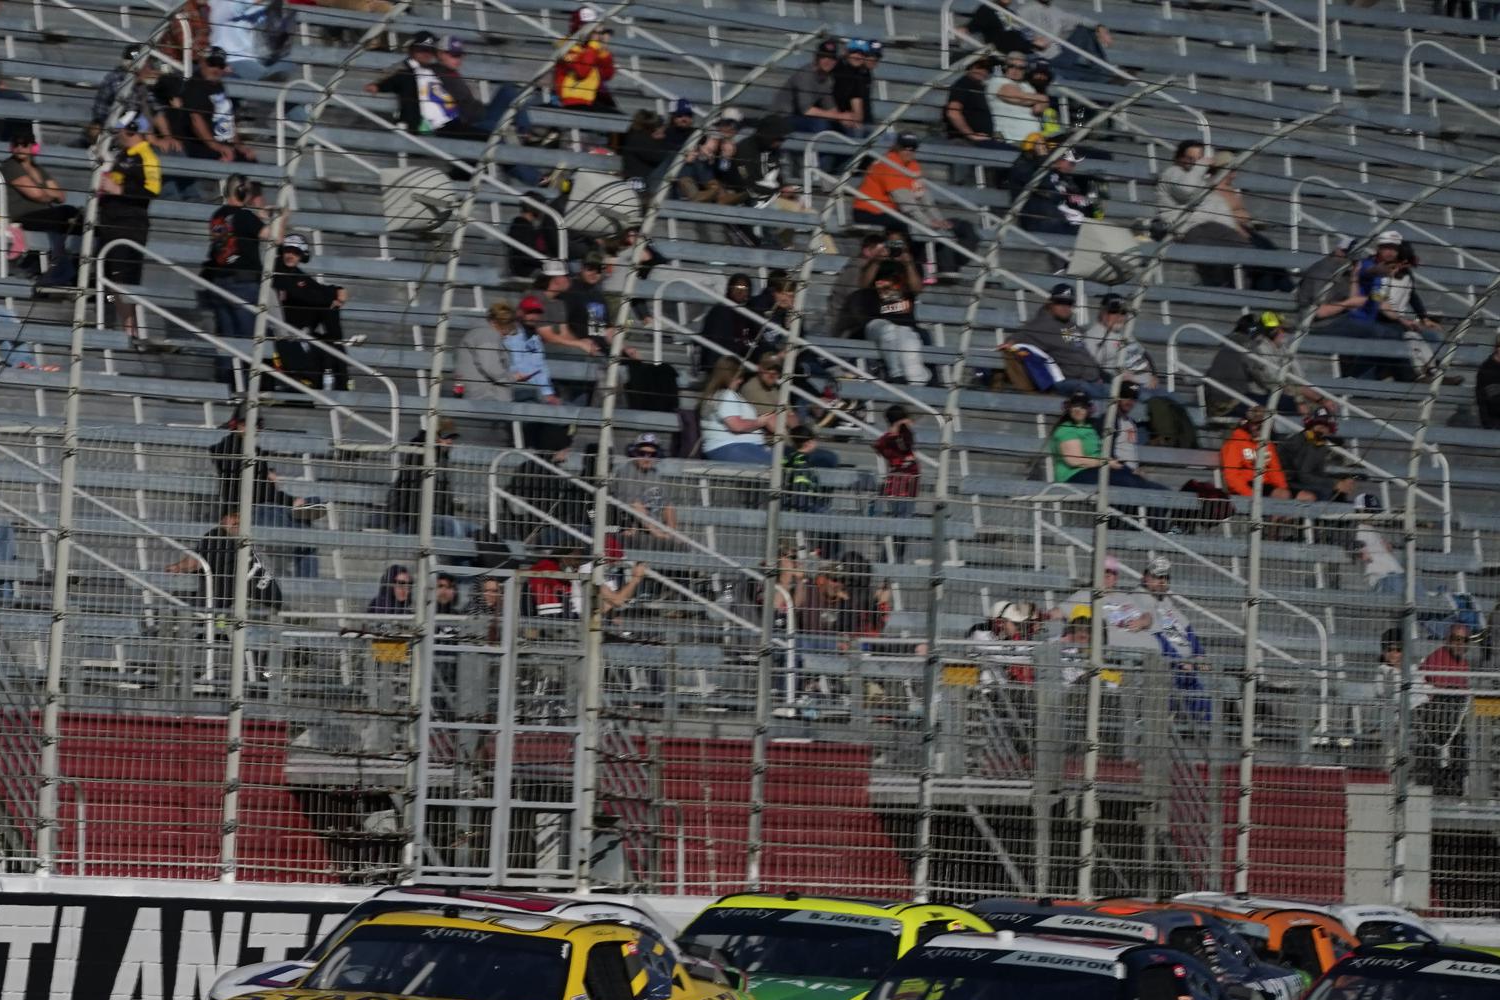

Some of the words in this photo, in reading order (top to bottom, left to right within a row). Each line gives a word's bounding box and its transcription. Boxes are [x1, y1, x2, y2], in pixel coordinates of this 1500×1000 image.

[808, 912, 882, 927] B.JONES
[980, 912, 1032, 923] finity
[1061, 917, 1145, 933] GRAGSON
[420, 928, 493, 943] xfinity
[1015, 954, 1115, 972] H.BURTON
[1349, 955, 1418, 970] xfinity
